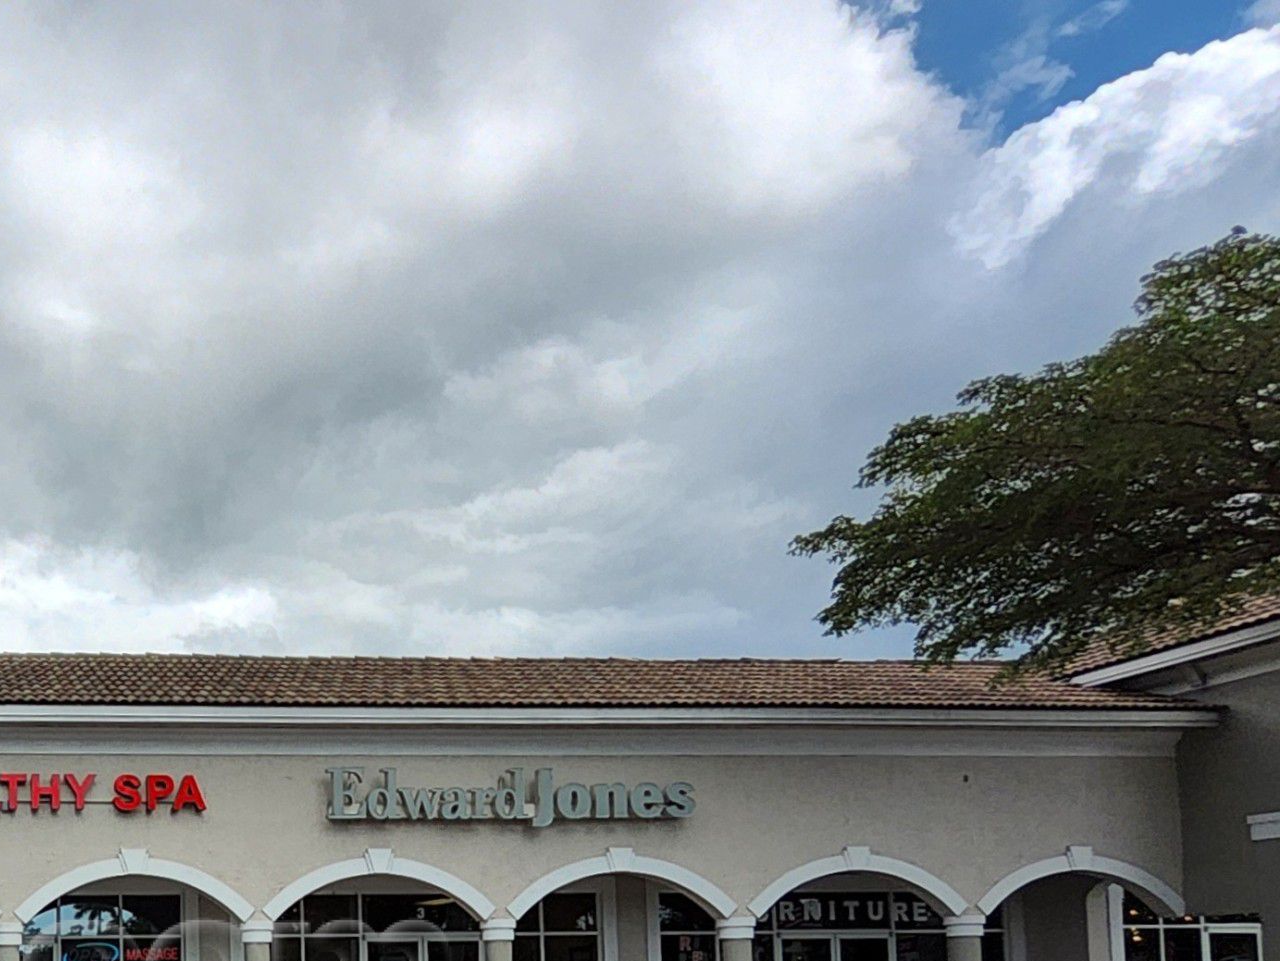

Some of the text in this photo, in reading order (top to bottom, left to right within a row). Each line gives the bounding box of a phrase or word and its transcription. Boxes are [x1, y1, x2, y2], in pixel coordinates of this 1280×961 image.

[112, 774, 207, 814] SPA
[324, 766, 697, 828] Edward Jones
[758, 899, 929, 923] RNITURE
[125, 947, 179, 961] MASSAGE
